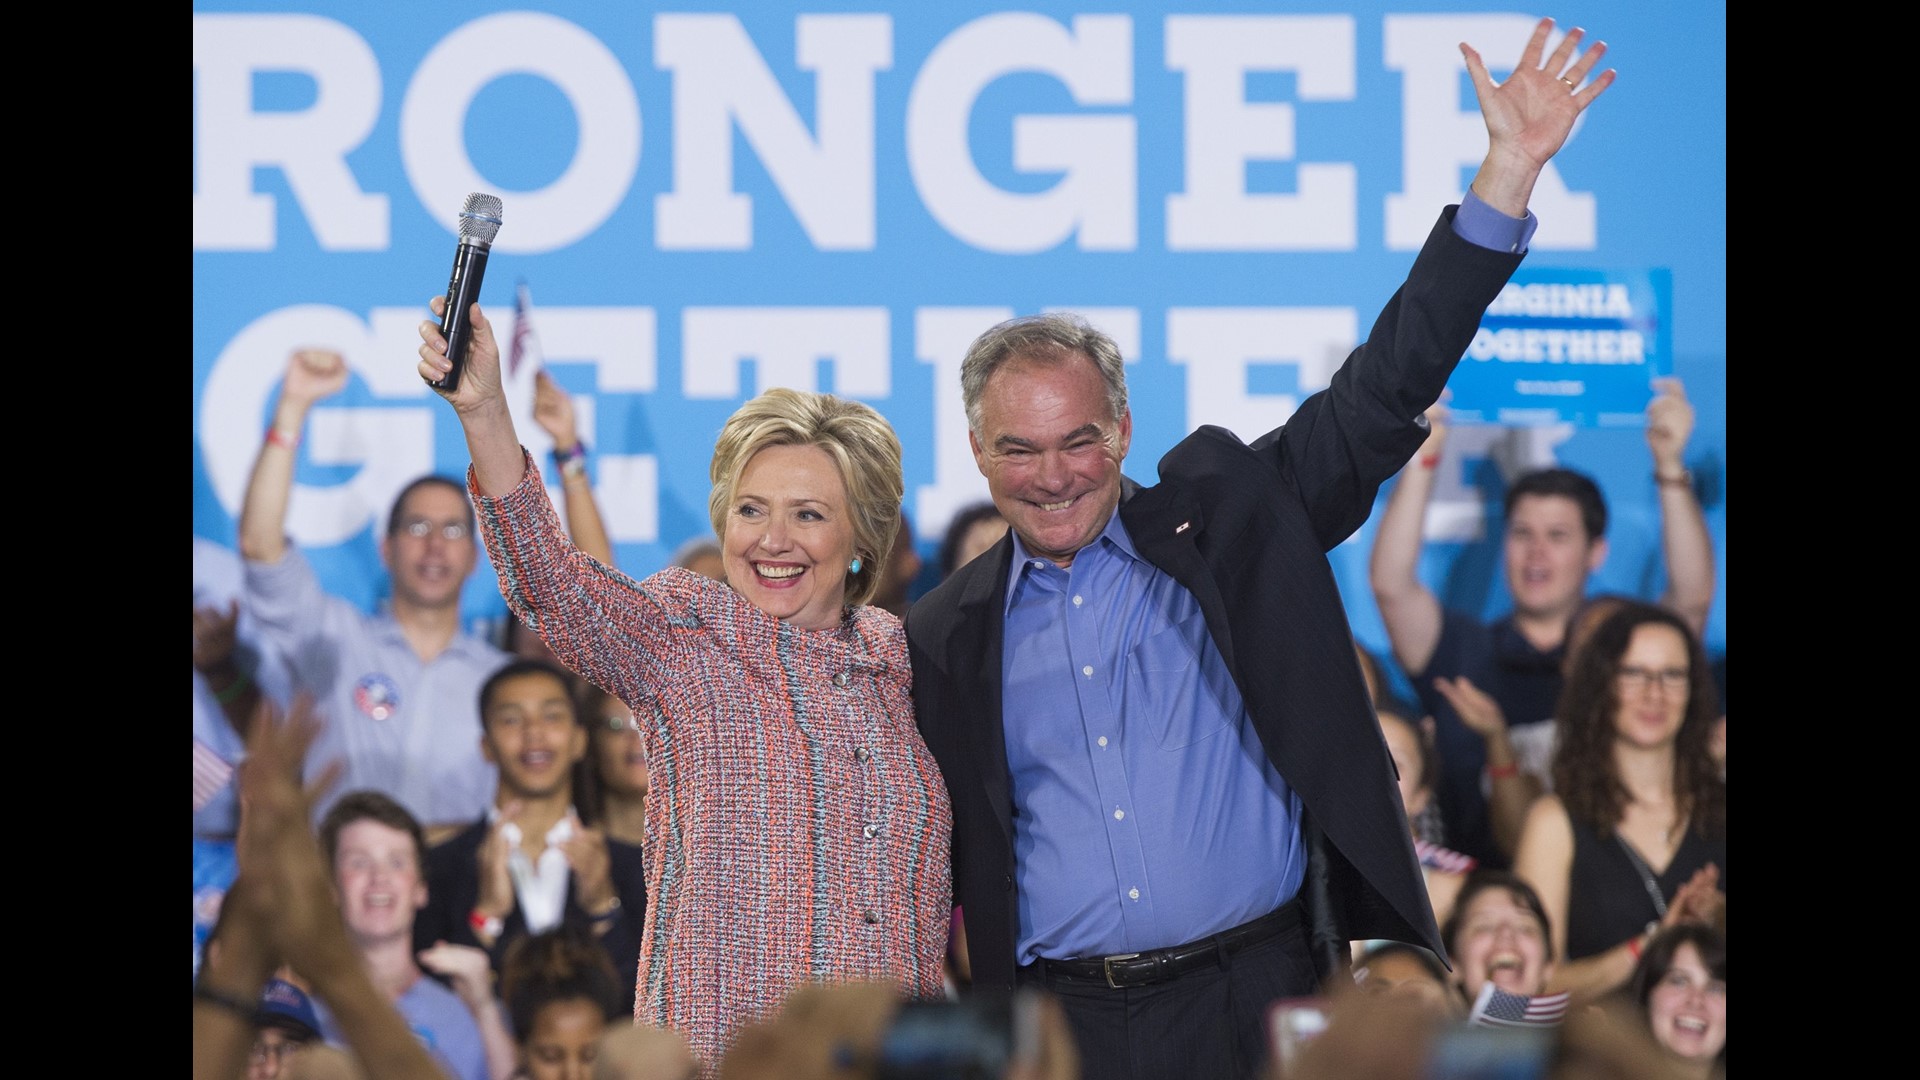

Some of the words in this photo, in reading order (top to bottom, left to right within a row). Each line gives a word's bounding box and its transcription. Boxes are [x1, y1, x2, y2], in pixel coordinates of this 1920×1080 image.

[193, 12, 1597, 253] RONGER
[202, 305, 1570, 546] GETE
[1459, 328, 1646, 365] OGETHER
